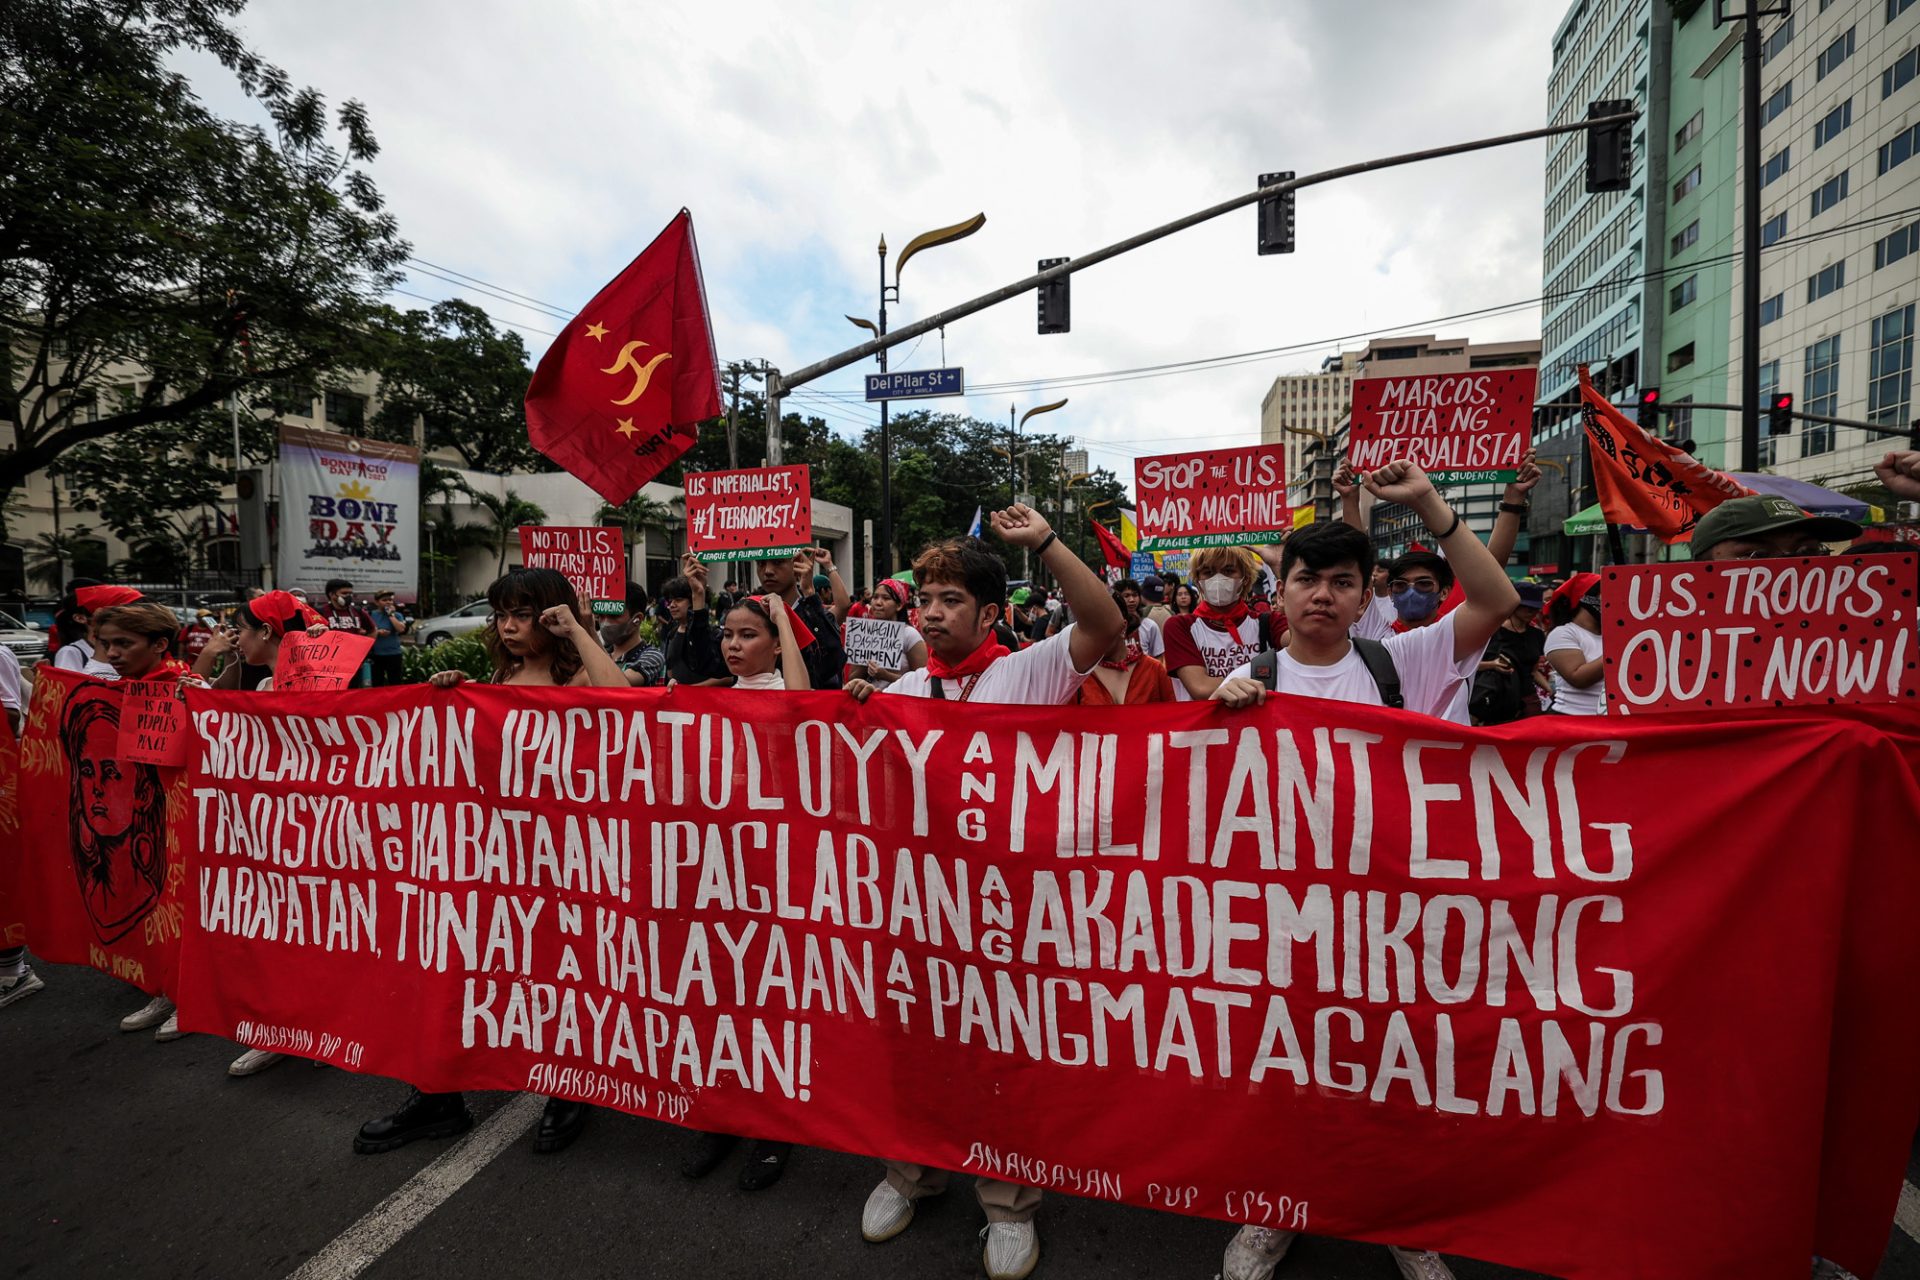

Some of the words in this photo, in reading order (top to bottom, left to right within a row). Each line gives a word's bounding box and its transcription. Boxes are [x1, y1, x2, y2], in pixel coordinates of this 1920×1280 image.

[871, 377, 891, 391] Del
[894, 374, 925, 389] Pilar
[928, 371, 942, 386] St
[1379, 375, 1496, 408] MARCOS,
[1376, 408, 1438, 436] TUTA
[1449, 406, 1491, 432] NG
[1351, 432, 1522, 470] IMPERYALISTA
[329, 466, 352, 476] DAY
[712, 472, 793, 495] IMPERIALIST,
[1139, 458, 1205, 491] STOP
[1209, 465, 1228, 479] THE
[1234, 454, 1282, 487] U.S.
[1448, 471, 1498, 482] STUDENTS
[308, 495, 398, 524] BONI
[693, 503, 716, 540] #1
[1140, 497, 1193, 532] WAR
[1199, 490, 1285, 527] MACHINE
[310, 519, 396, 544] DAY
[532, 531, 551, 550] NO
[555, 531, 570, 550] TO
[579, 529, 615, 555] U.S.
[1157, 536, 1190, 548] LEAGUE
[1193, 536, 1201, 544] OF
[1203, 533, 1235, 545] FILIPINO
[1236, 531, 1281, 544] STUDENTS
[527, 553, 585, 574] MILITARY
[592, 556, 616, 576] AID
[703, 552, 726, 560] LEAGUE
[727, 551, 736, 559] OF
[738, 549, 763, 559] FILIPINO
[766, 547, 801, 557] STUDENTS
[567, 575, 611, 599] SRAEL
[1628, 572, 1705, 621] U.S.
[1720, 565, 1902, 622] TROOPS,
[592, 601, 625, 613] STUDENTS
[847, 619, 900, 640] BUWAGIN
[852, 634, 902, 651] PASISTANG
[847, 648, 903, 668] REHIMEN!
[1236, 655, 1250, 666] SA
[1618, 627, 1756, 705] OUT
[1762, 628, 1908, 703] NOW!
[145, 700, 154, 712] IS
[158, 702, 172, 715] FOR
[137, 714, 178, 733] PEOPLE'S
[137, 734, 168, 751] PEACE
[315, 716, 349, 786] NG
[346, 706, 486, 795] BAYAN,
[957, 731, 996, 842] ANG
[193, 787, 376, 871] TRADISYON
[376, 803, 405, 872] NG
[410, 802, 632, 903] KABATAAN!
[651, 821, 973, 952] IPAGLABAN
[979, 865, 1014, 963] ANG
[1021, 869, 1634, 1017] AKADEMIKONG
[199, 866, 382, 959] KARAPATAN,
[395, 882, 546, 976] TUNAY
[556, 901, 583, 982] NA
[596, 906, 877, 1019] KALAYAAN
[887, 948, 917, 1026] AT
[926, 956, 1665, 1116] PANGMATAGALANG
[236, 1020, 313, 1053] ANAKBAYAN
[315, 1032, 342, 1059] PUP
[462, 977, 811, 1103] KAPAYAPAAN!
[526, 1063, 647, 1110] ANAKBAYAN
[657, 1090, 689, 1123] PUP
[962, 1141, 1122, 1201] ANAKBAYAN
[1147, 1183, 1198, 1209] PUP
[1225, 1190, 1309, 1231] CPSPA
